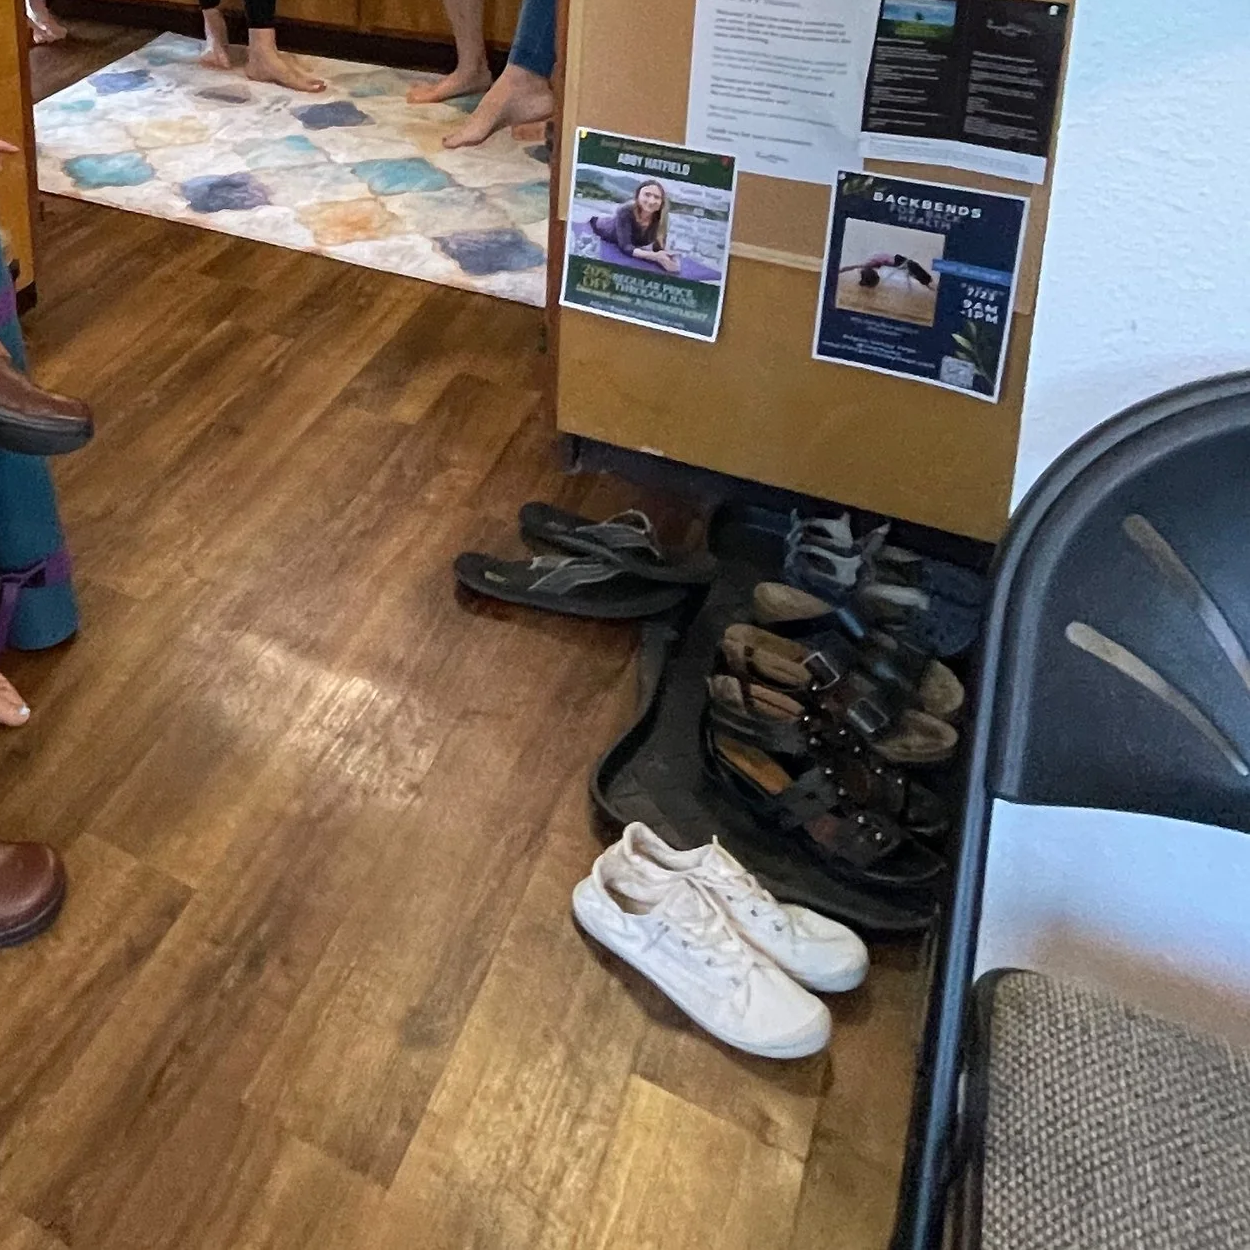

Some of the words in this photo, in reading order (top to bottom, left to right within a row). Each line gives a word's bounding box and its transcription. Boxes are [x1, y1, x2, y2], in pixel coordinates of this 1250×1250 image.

[872, 191, 982, 219] BACKBENDS
[897, 214, 951, 231] HEALTH
[962, 299, 999, 315] 9AM
